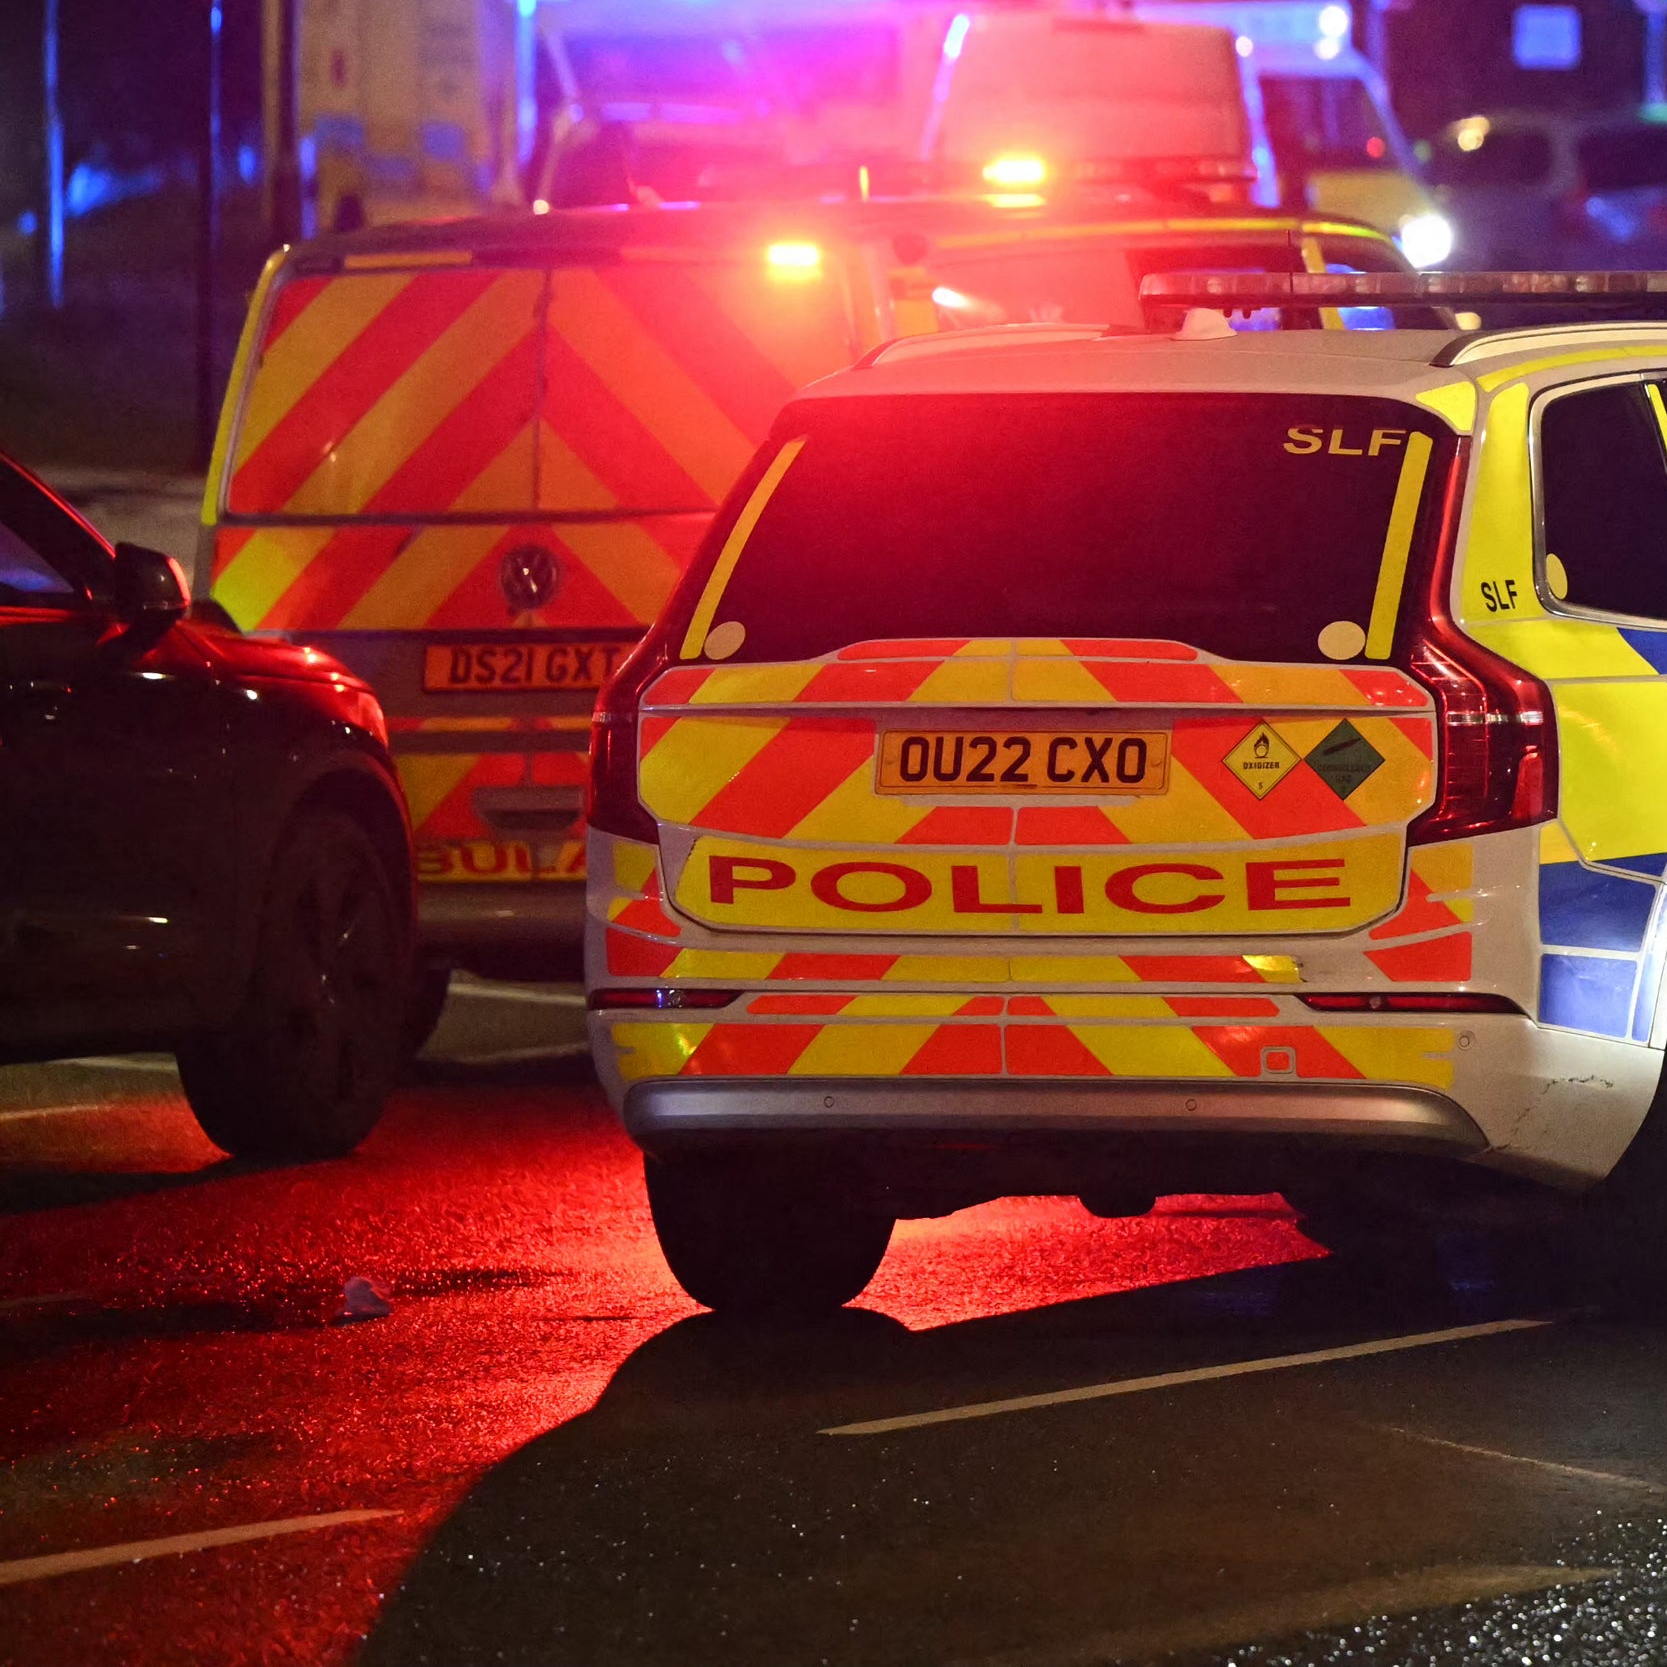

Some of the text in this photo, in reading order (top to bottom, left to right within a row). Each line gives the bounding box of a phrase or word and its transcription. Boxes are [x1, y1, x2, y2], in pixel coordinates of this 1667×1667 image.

[1283, 423, 1406, 456] SLF
[1481, 579, 1517, 613] SLF
[450, 648, 533, 683] DS21
[900, 736, 1148, 784] OU22 CXO
[1258, 782, 1264, 790] 5
[709, 855, 1351, 915] POLICE
